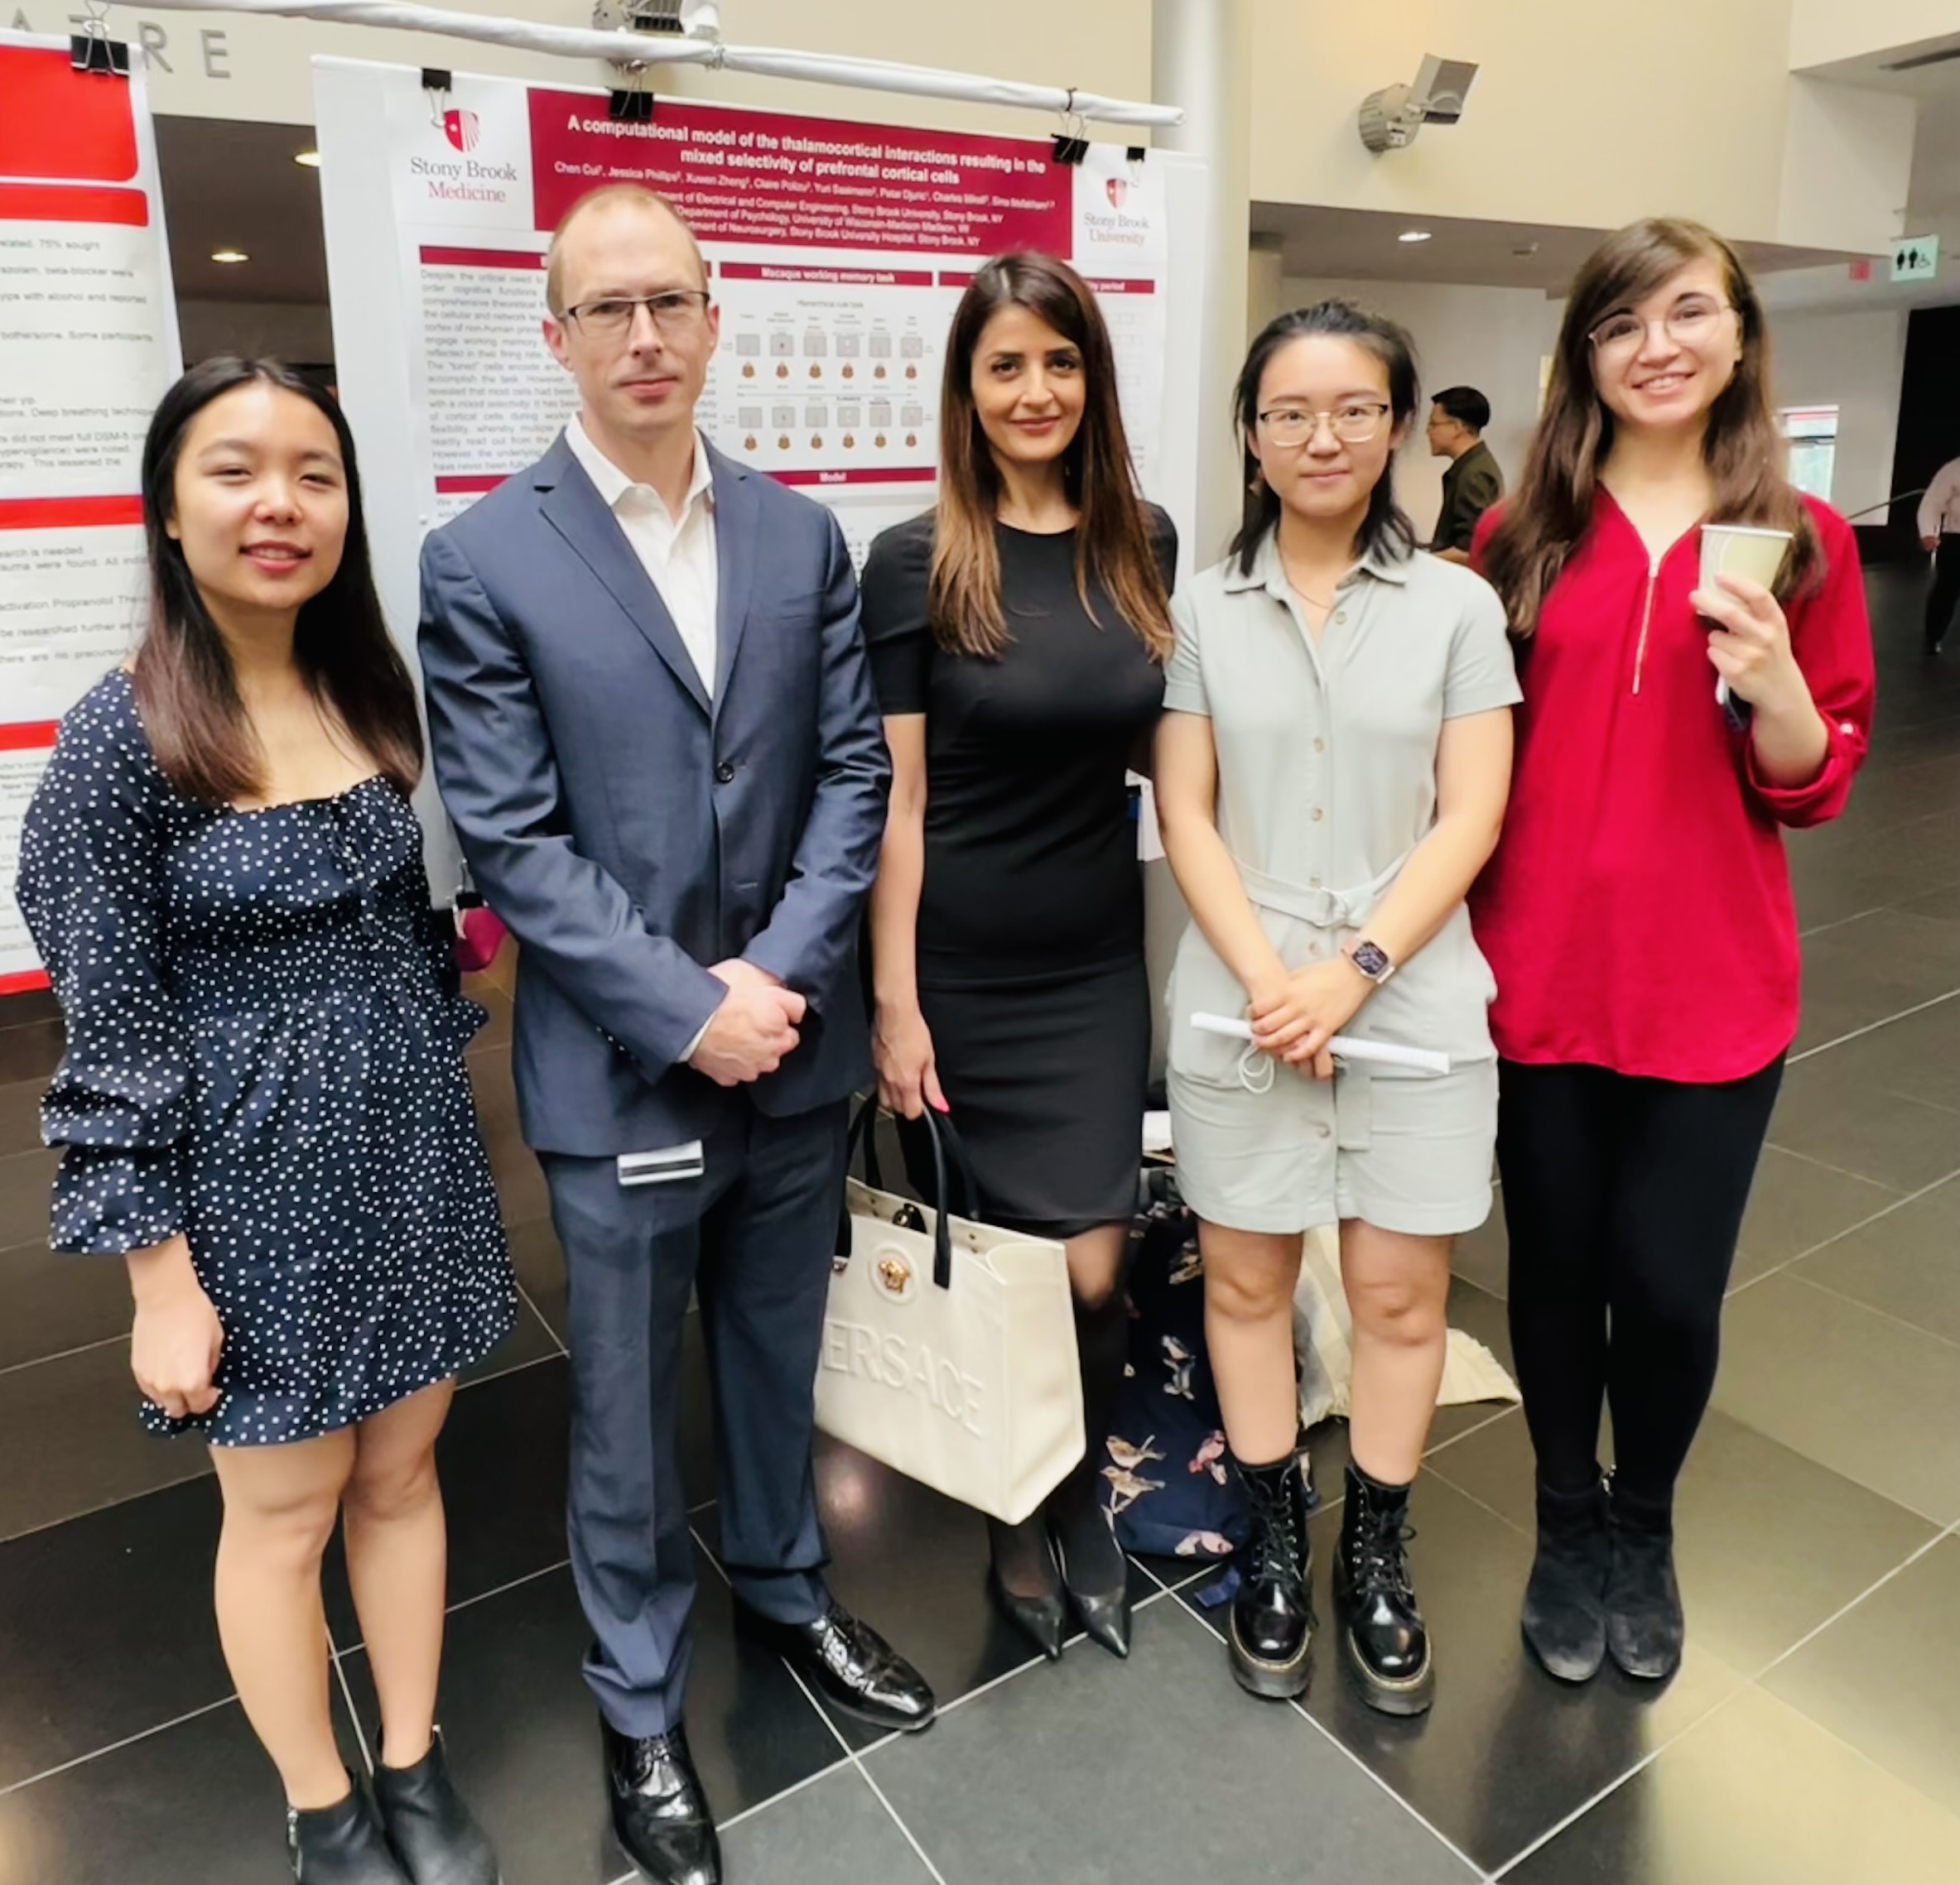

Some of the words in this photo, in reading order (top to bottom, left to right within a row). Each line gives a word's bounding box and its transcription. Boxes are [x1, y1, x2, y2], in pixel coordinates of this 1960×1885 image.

[568, 114, 580, 130] A
[582, 119, 688, 141] computational
[691, 130, 736, 146] model
[739, 132, 754, 147] of
[756, 133, 778, 149] the
[782, 137, 883, 159] thalamocortical
[884, 145, 957, 166] interactions
[960, 155, 1012, 174] resulting
[1014, 157, 1024, 172] in
[1027, 159, 1046, 174] the
[411, 156, 461, 180] Stony
[466, 160, 518, 180] Brook
[681, 149, 725, 165] mixed
[727, 152, 797, 175] selectivity
[798, 158, 814, 172] of
[816, 161, 879, 179] prefrontal
[881, 166, 929, 182] cortical
[930, 170, 960, 185] cells
[428, 180, 506, 203] Medicine
[685, 192, 695, 202] of
[696, 193, 736, 205] Electrical
[738, 196, 754, 206] and
[756, 198, 797, 210] Computer
[1084, 211, 1115, 229] Stony
[1118, 214, 1149, 228] Brook
[1090, 228, 1144, 247] University
[762, 267, 802, 281] Macaque
[804, 269, 838, 282] working
[840, 272, 874, 283] memory
[876, 272, 895, 282] task
[821, 1316, 985, 1440] ERSACE
